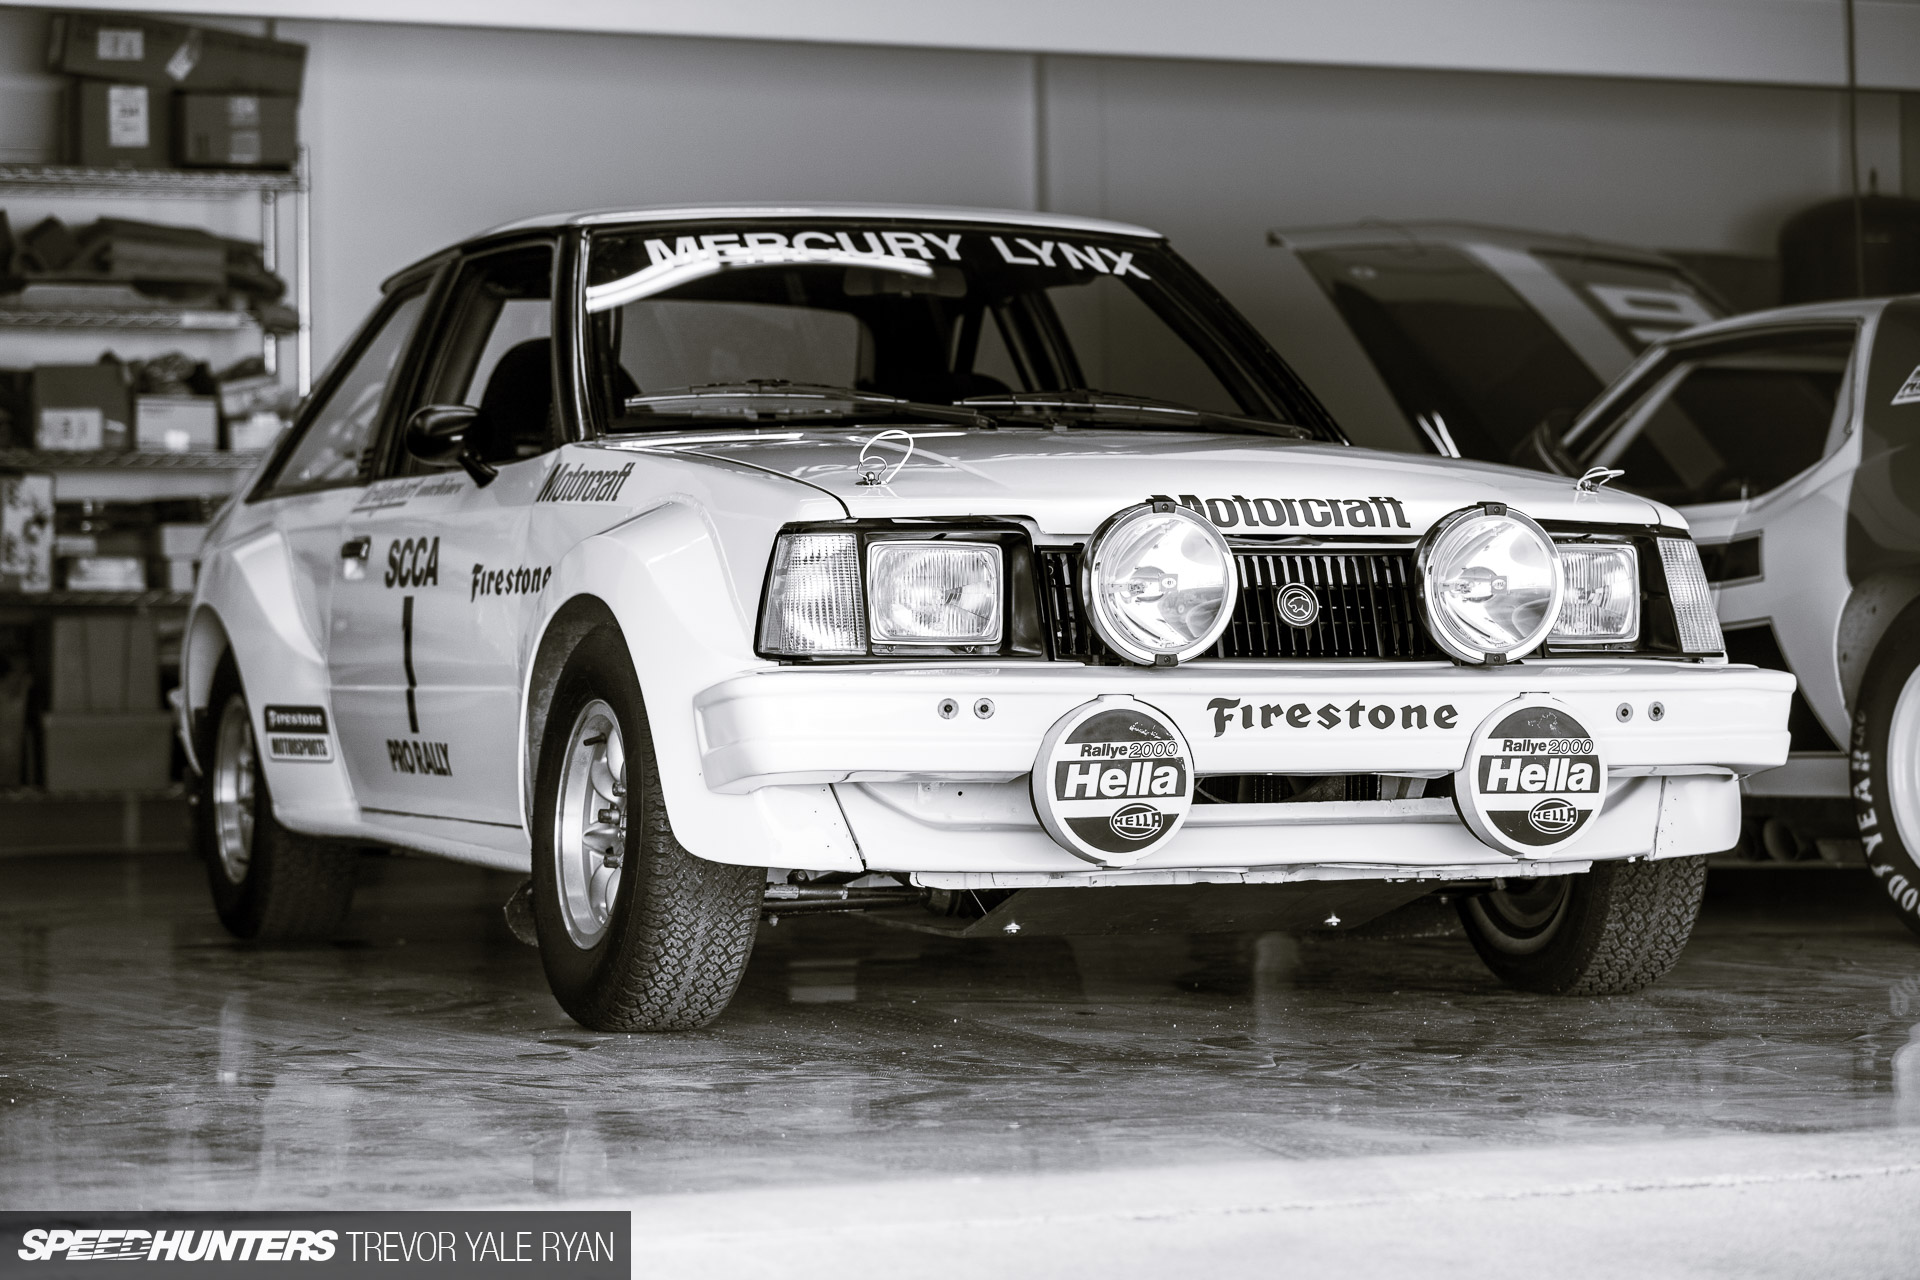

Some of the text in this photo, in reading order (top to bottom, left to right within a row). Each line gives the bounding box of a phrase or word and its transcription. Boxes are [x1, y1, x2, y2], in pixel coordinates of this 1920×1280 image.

[644, 231, 1152, 280] MERCURY LYNX
[536, 462, 636, 503] Motorcraft
[384, 536, 440, 588] SCCA
[470, 562, 552, 603] Firestone
[268, 710, 323, 728] Firestone
[1206, 697, 1459, 738] Firestone
[271, 737, 329, 757] MOTORSPORTS
[386, 739, 453, 777] PRO RALLY
[1080, 741, 1179, 759] Rallye 2000
[1502, 739, 1594, 755] Rallye 2000
[1064, 761, 1179, 798] Hella
[1486, 758, 1594, 792] Hella
[1114, 811, 1162, 828] HELLA
[1533, 807, 1577, 823] HELLA
